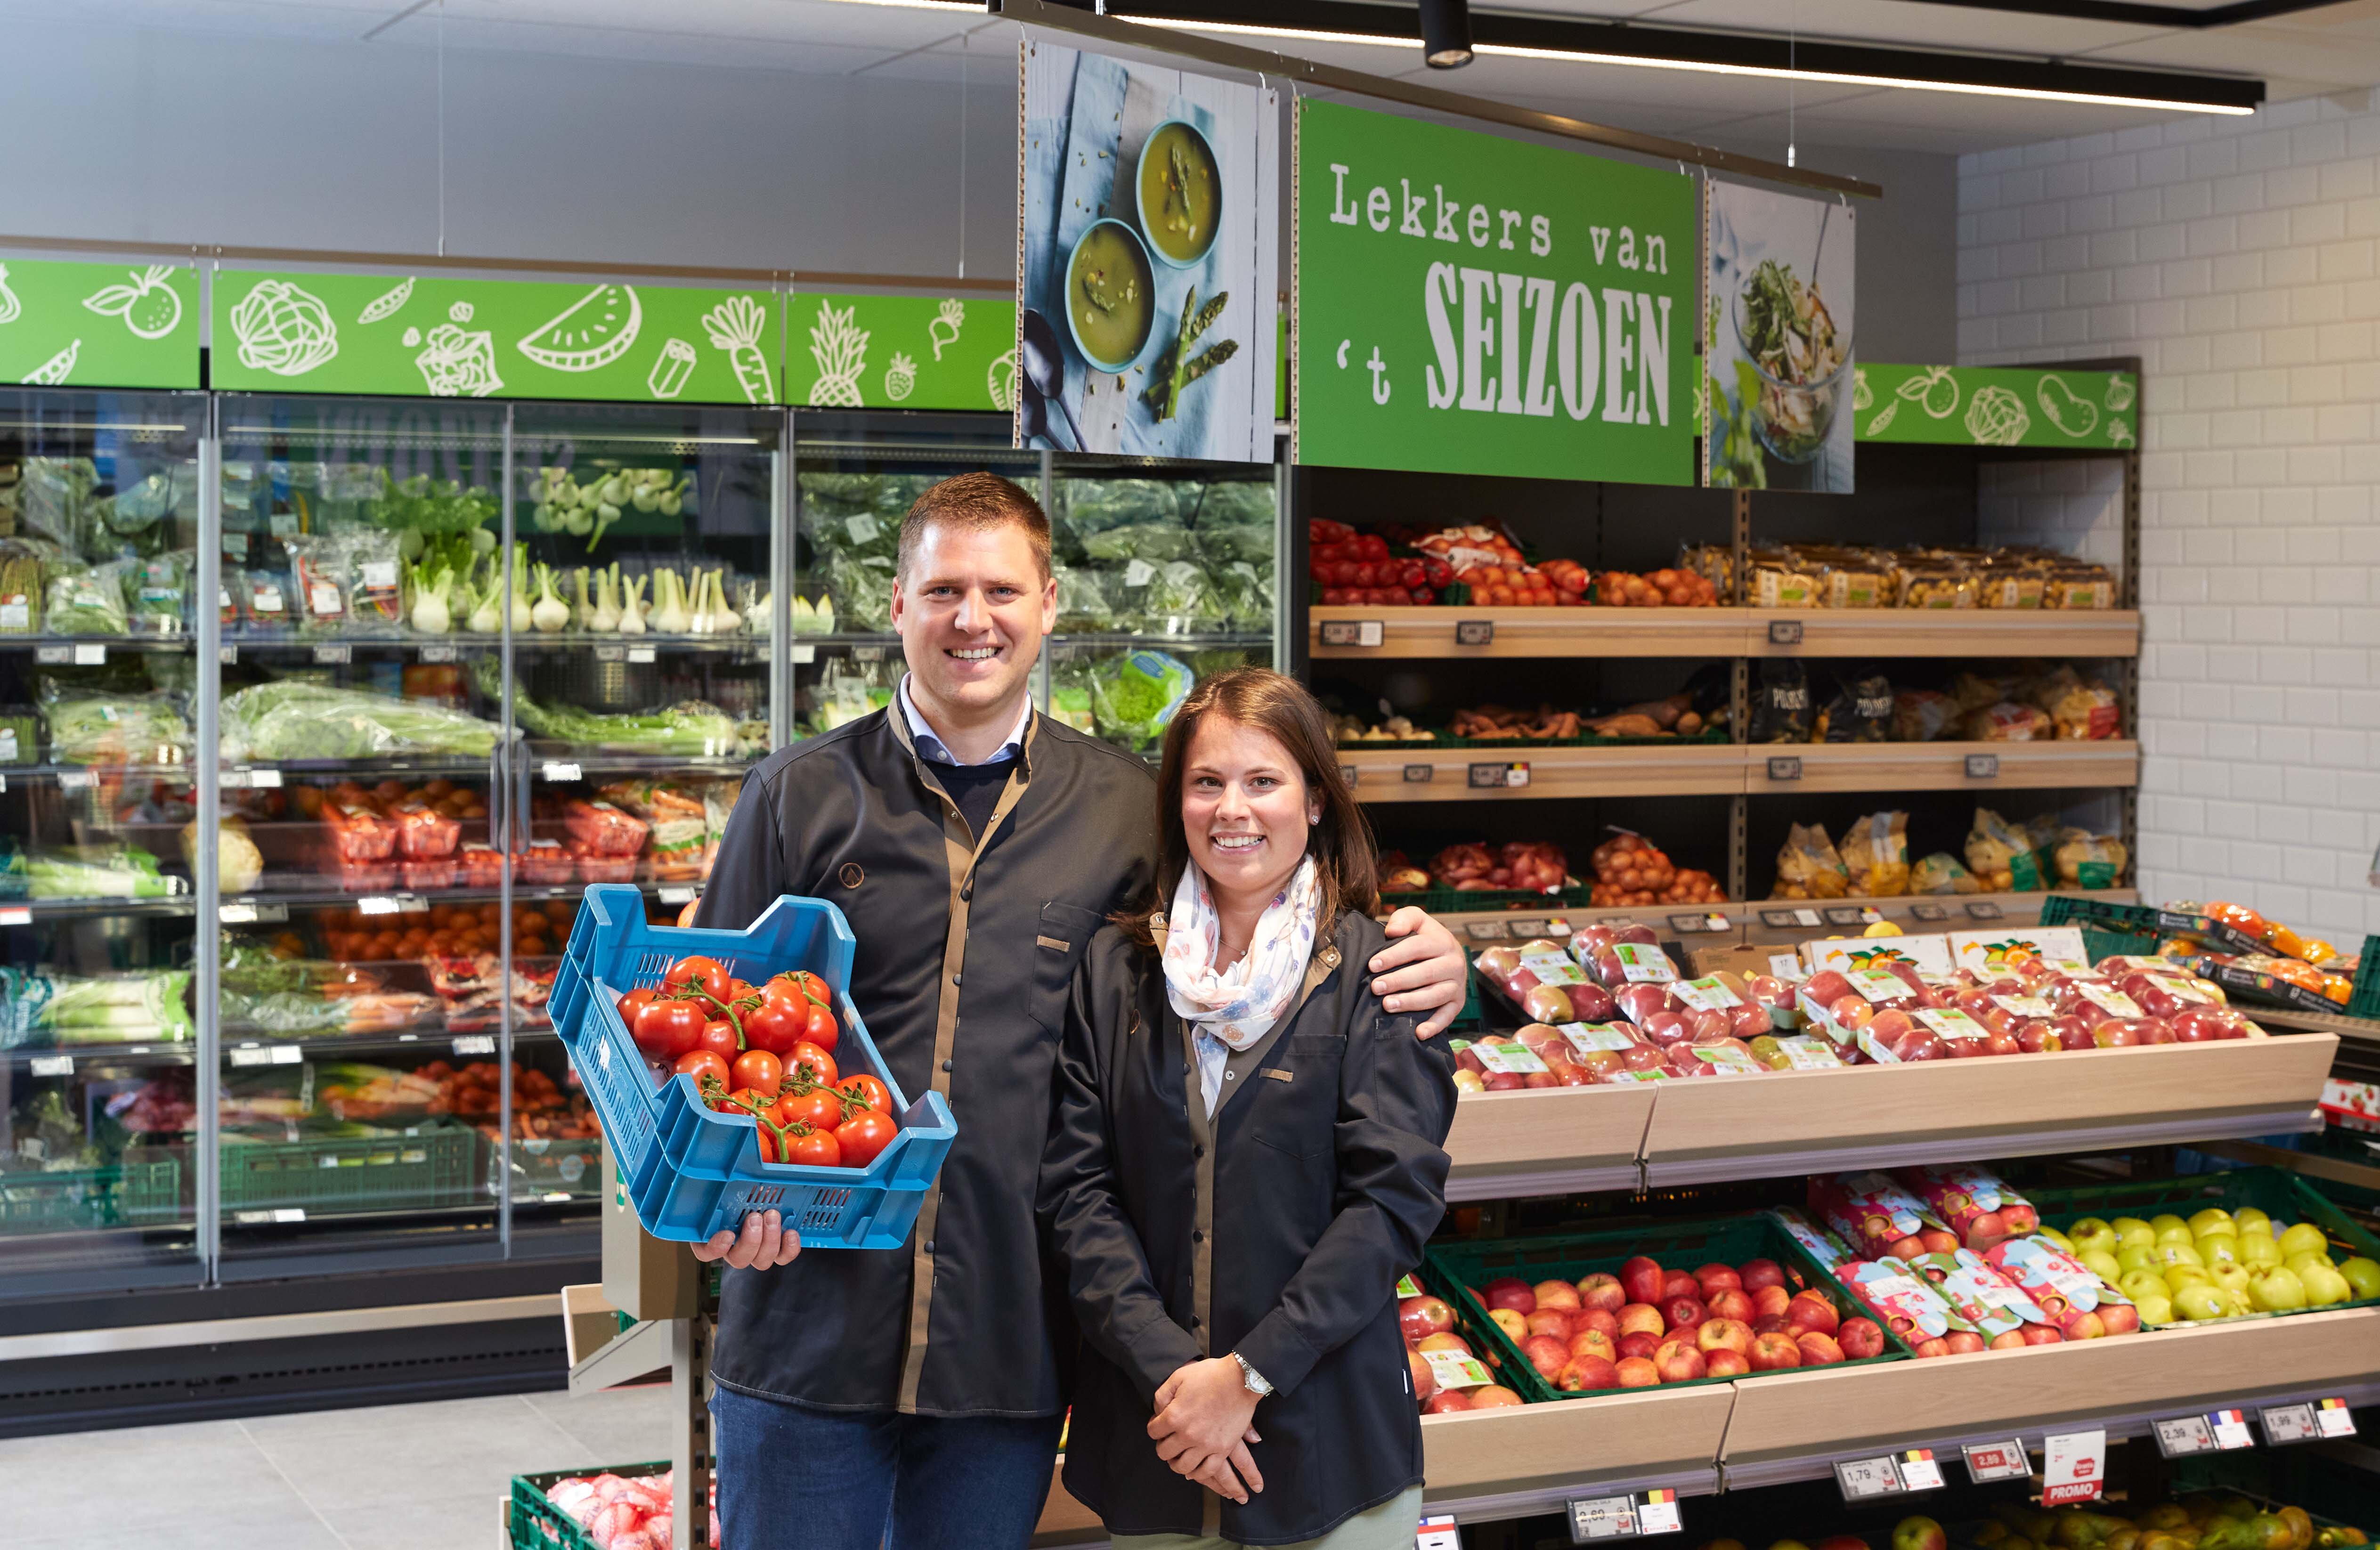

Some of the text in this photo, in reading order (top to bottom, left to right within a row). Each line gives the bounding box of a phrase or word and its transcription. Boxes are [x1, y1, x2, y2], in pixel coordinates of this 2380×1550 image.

[1330, 163, 1668, 275] Lekkers van
[1425, 261, 1672, 426] SEIZOEN
[1848, 1469, 1870, 1482] 1,79
[2050, 1483, 2094, 1499] PROMO
